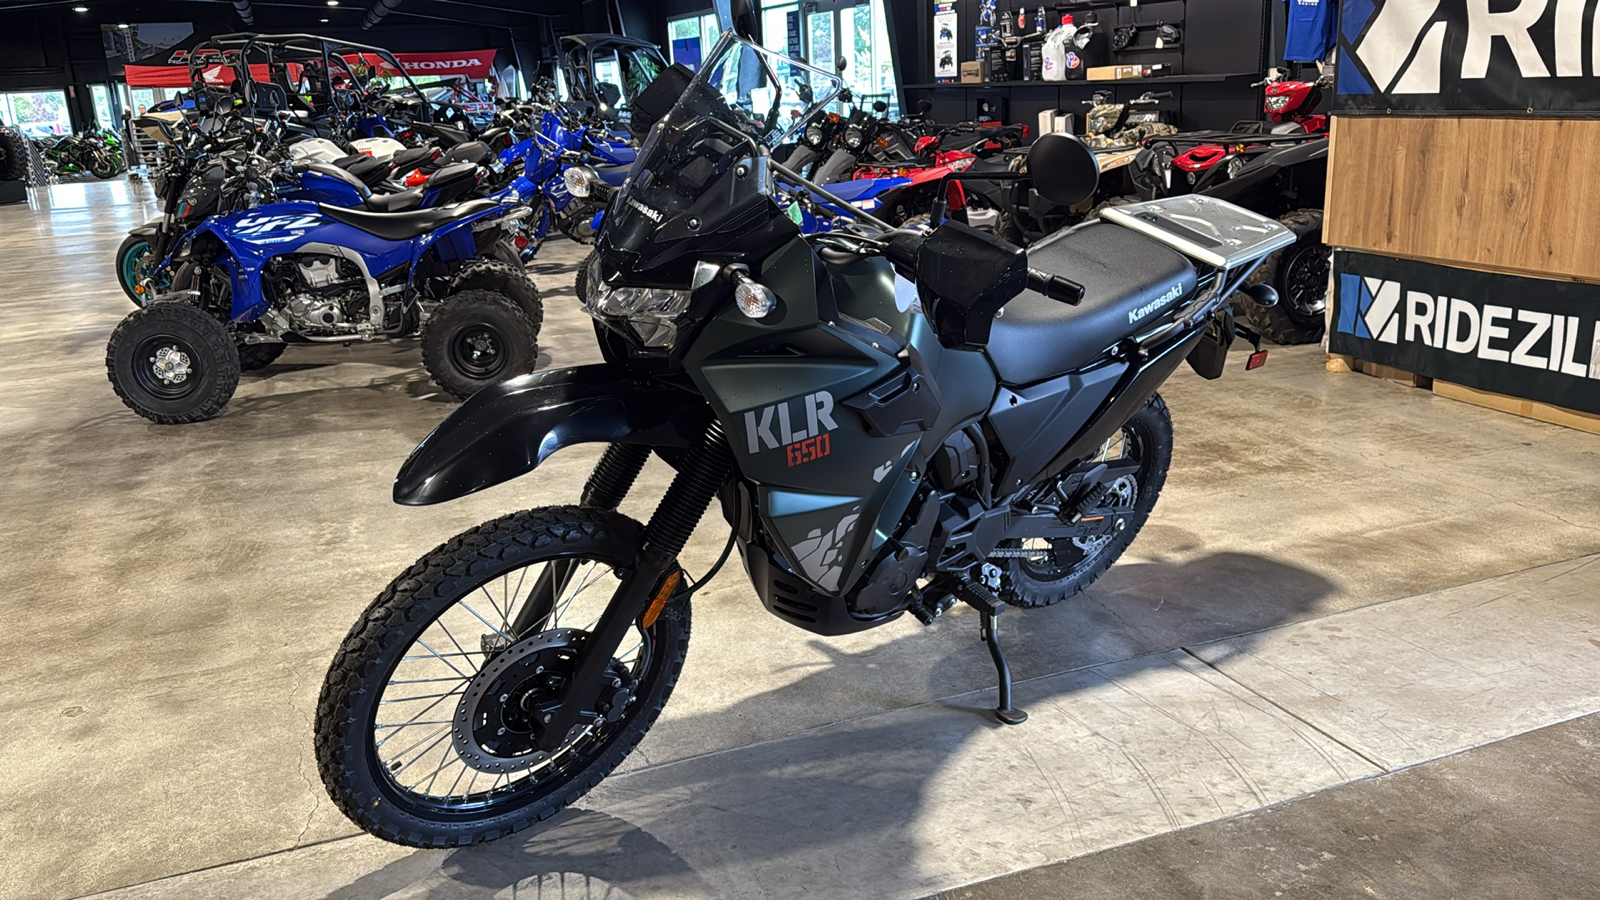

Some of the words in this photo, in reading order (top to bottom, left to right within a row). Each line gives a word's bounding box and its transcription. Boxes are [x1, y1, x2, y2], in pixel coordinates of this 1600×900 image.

[1460, 0, 1600, 79] RI
[402, 58, 482, 70] HONDA
[626, 195, 664, 223] Kawasaki
[1128, 283, 1183, 324] Kawasaki
[744, 391, 839, 454] KLR
[786, 433, 830, 467] 650
